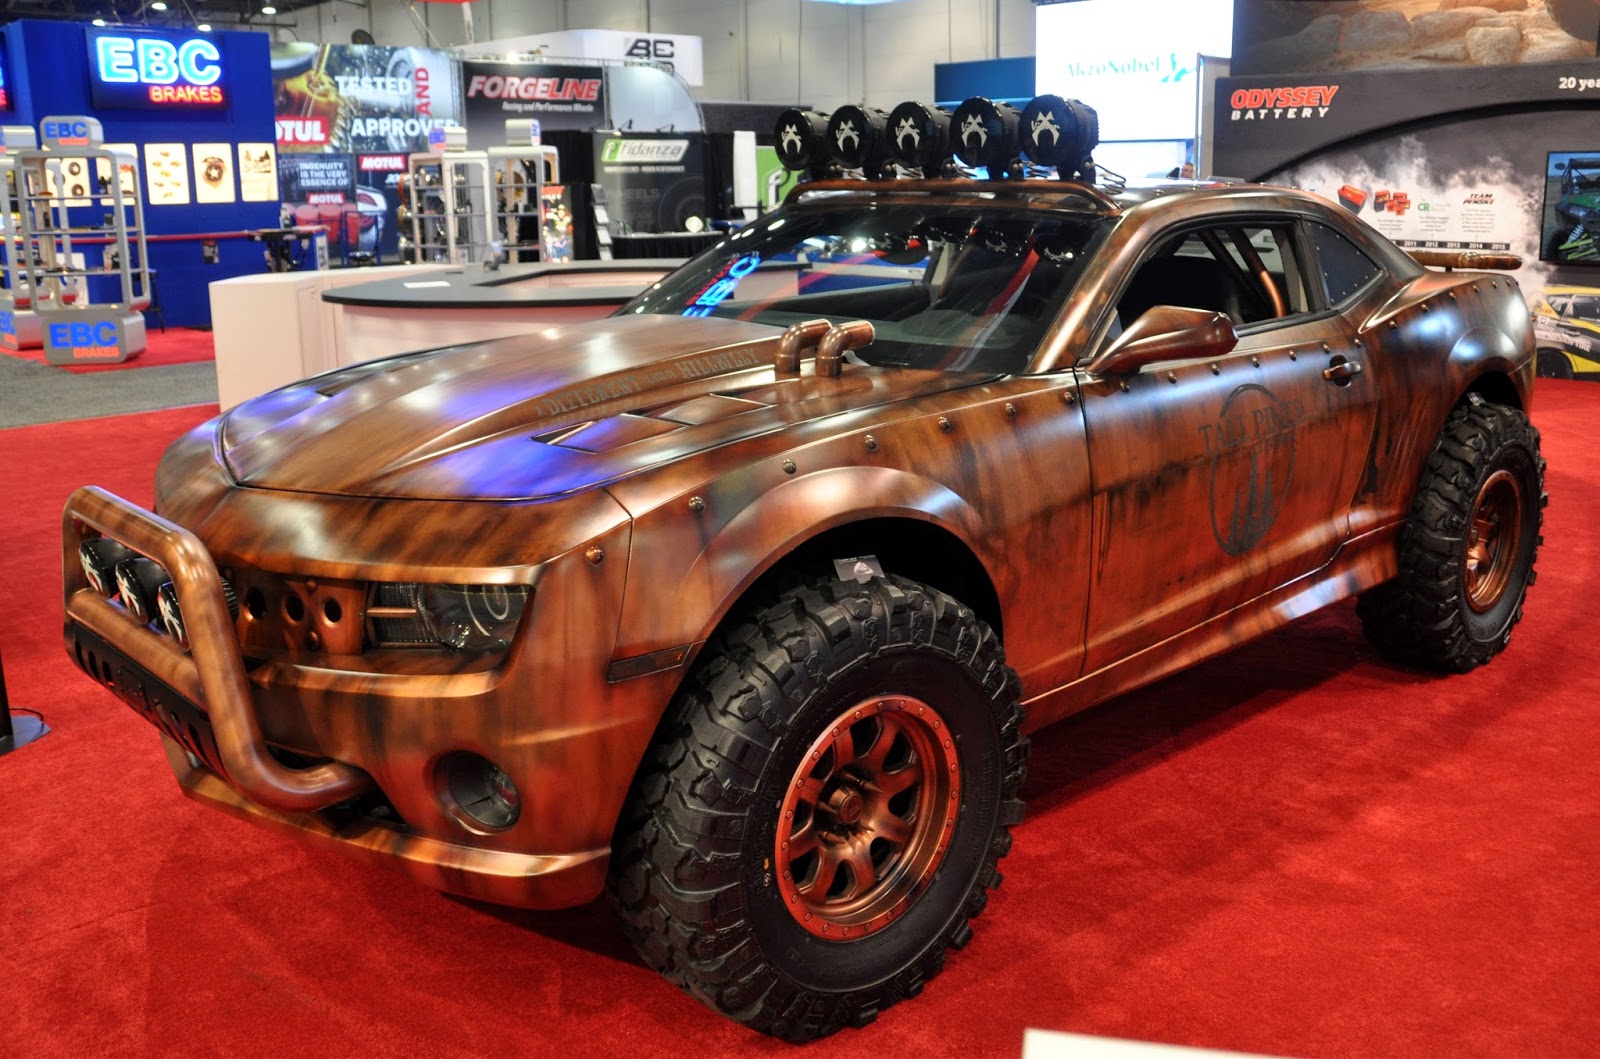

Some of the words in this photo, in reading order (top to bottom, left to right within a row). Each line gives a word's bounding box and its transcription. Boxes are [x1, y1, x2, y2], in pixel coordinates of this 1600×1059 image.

[96, 36, 221, 86] EBC
[335, 76, 412, 96] TESTED
[467, 75, 602, 101] FORGELINE
[1558, 76, 1577, 89] 20
[149, 85, 223, 103] BRAKES
[415, 67, 433, 117] AND
[1230, 85, 1339, 109] ODYSSEY
[1231, 107, 1329, 120] BATTERY
[44, 122, 87, 138] EBC
[275, 120, 325, 142] OTUL
[300, 162, 343, 170] INGENUITY
[361, 156, 405, 169] MOTUL
[310, 170, 326, 178] THE
[327, 170, 347, 179] VERY
[301, 178, 335, 187] ESSENCE
[309, 194, 343, 204] MOTUL
[1446, 241, 1460, 249] 2013
[49, 321, 118, 348] EBC
[73, 347, 120, 358] BRAKES
